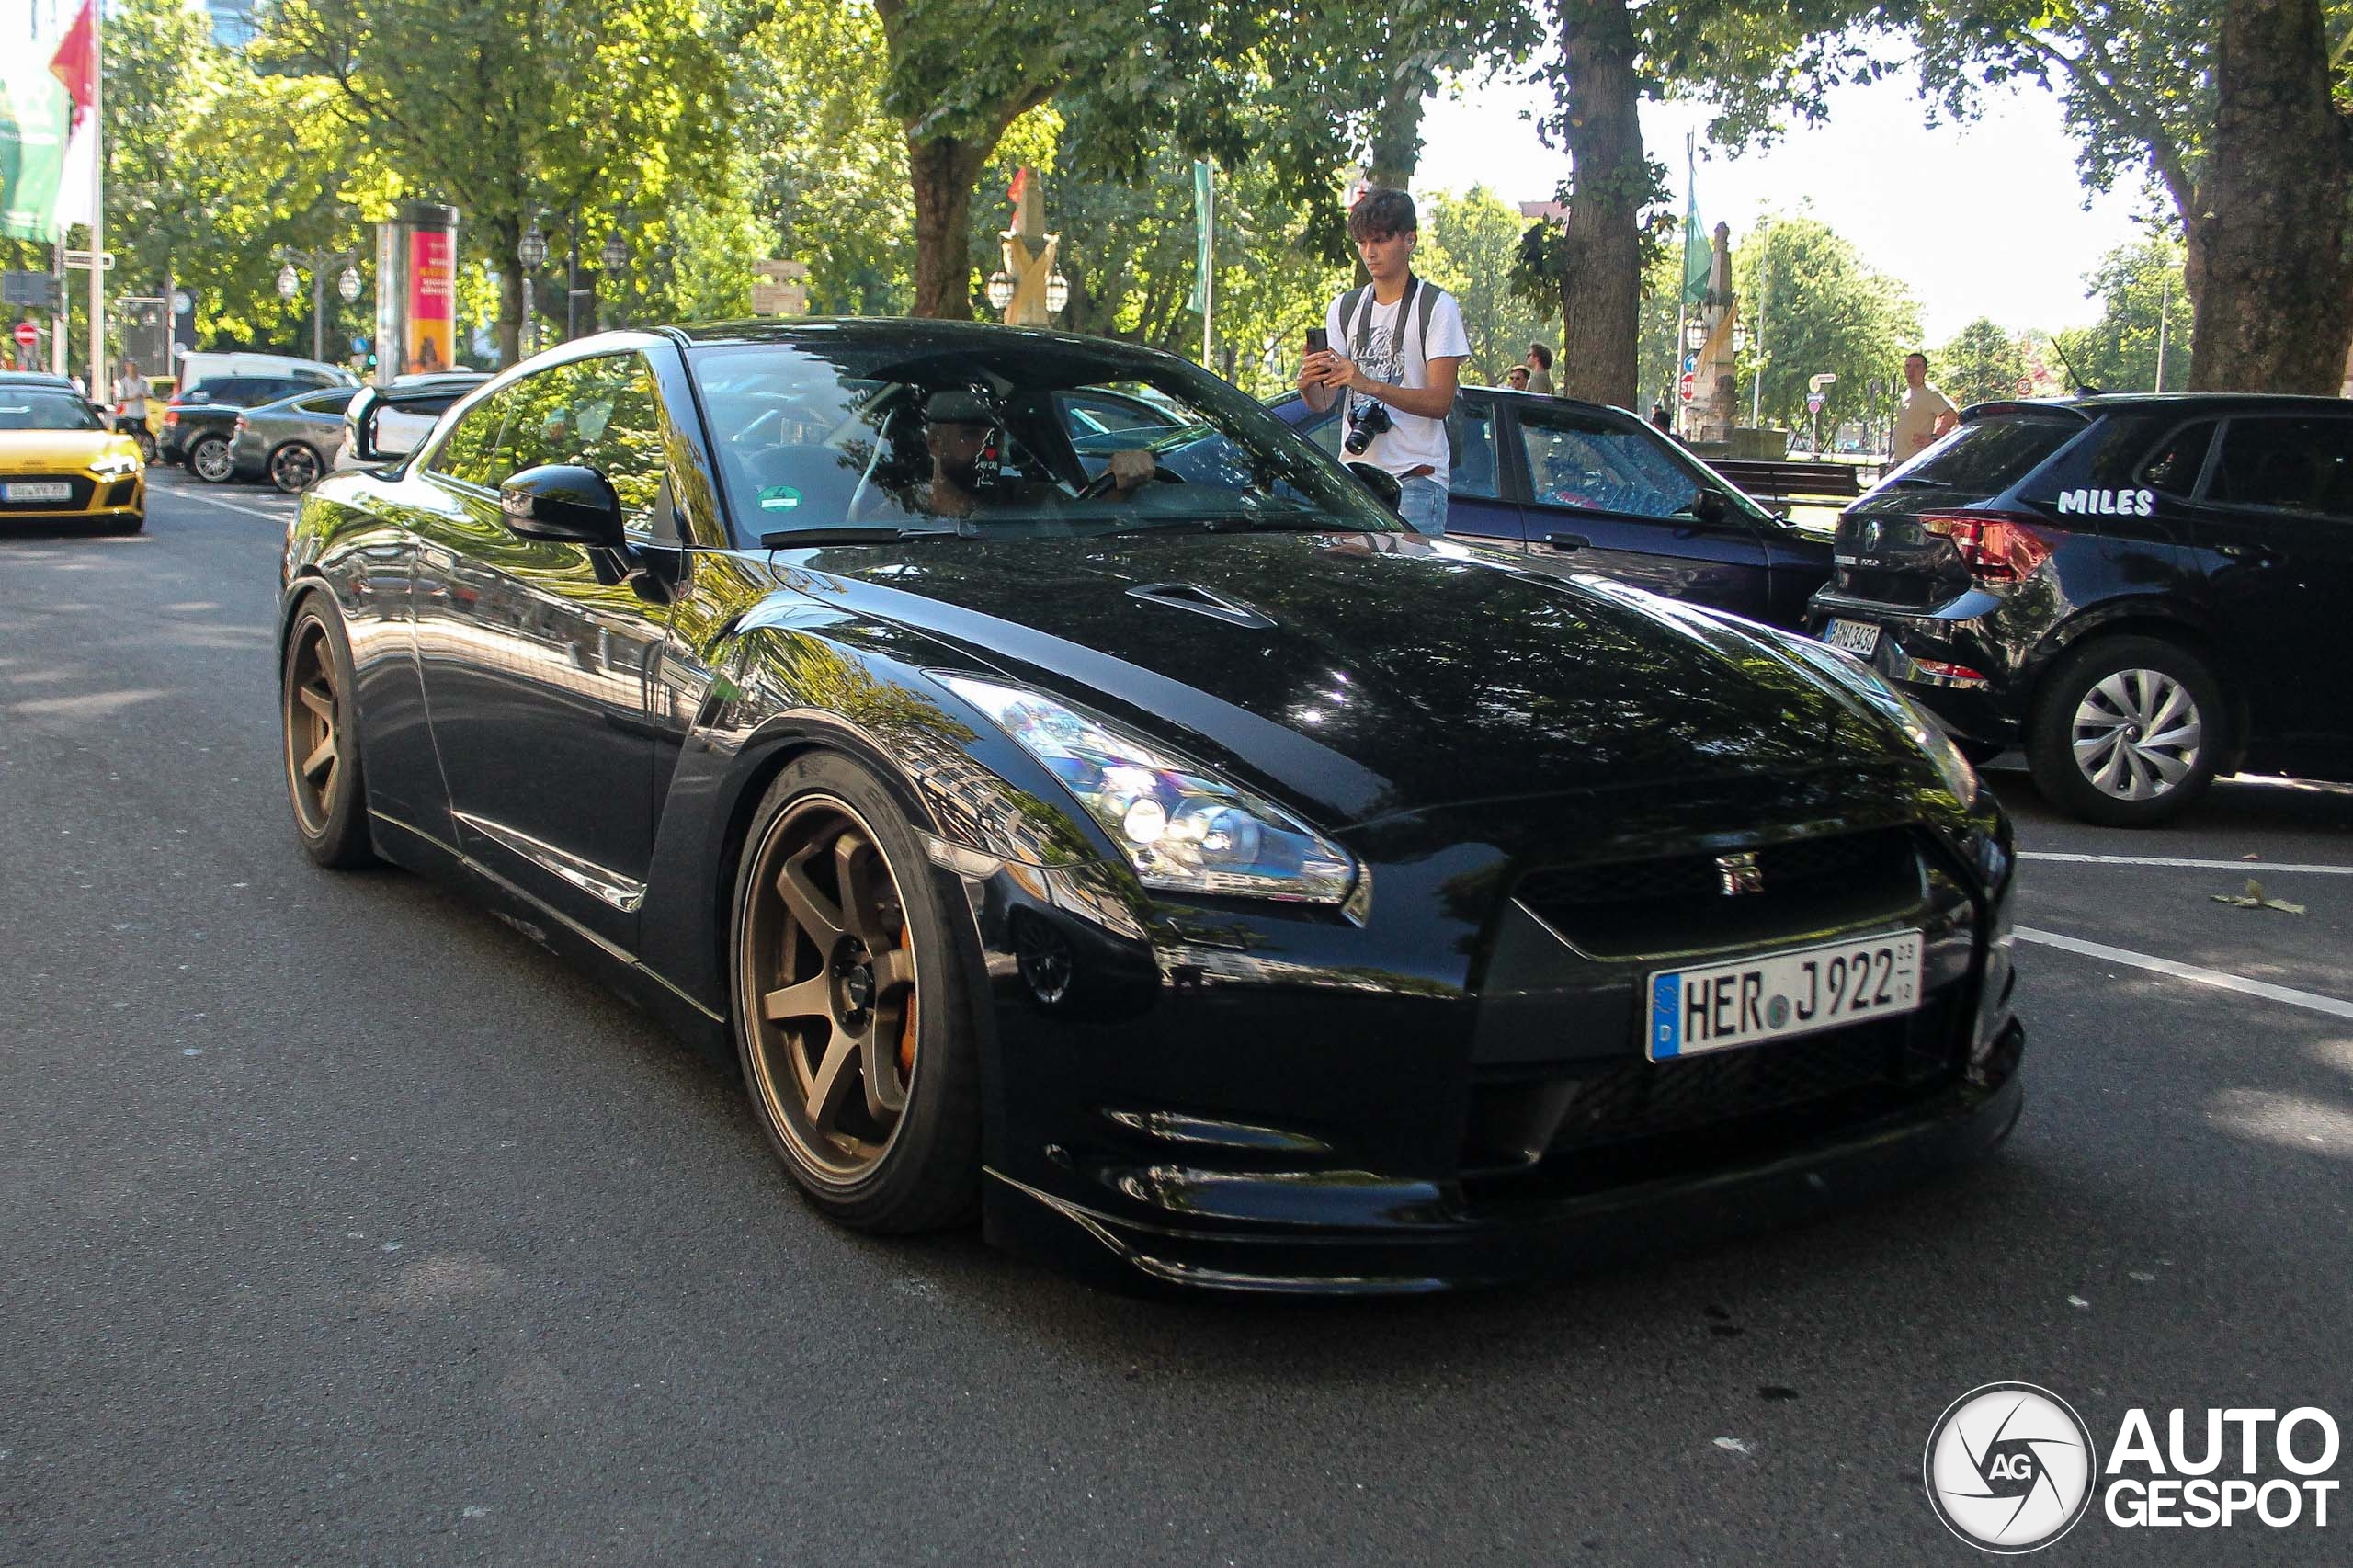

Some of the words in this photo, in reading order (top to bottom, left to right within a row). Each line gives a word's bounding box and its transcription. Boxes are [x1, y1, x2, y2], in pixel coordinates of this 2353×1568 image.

[1681, 381, 1695, 394] ST
[772, 486, 787, 499] 4
[2058, 488, 2154, 517] MILES
[1684, 971, 1761, 1042] HER
